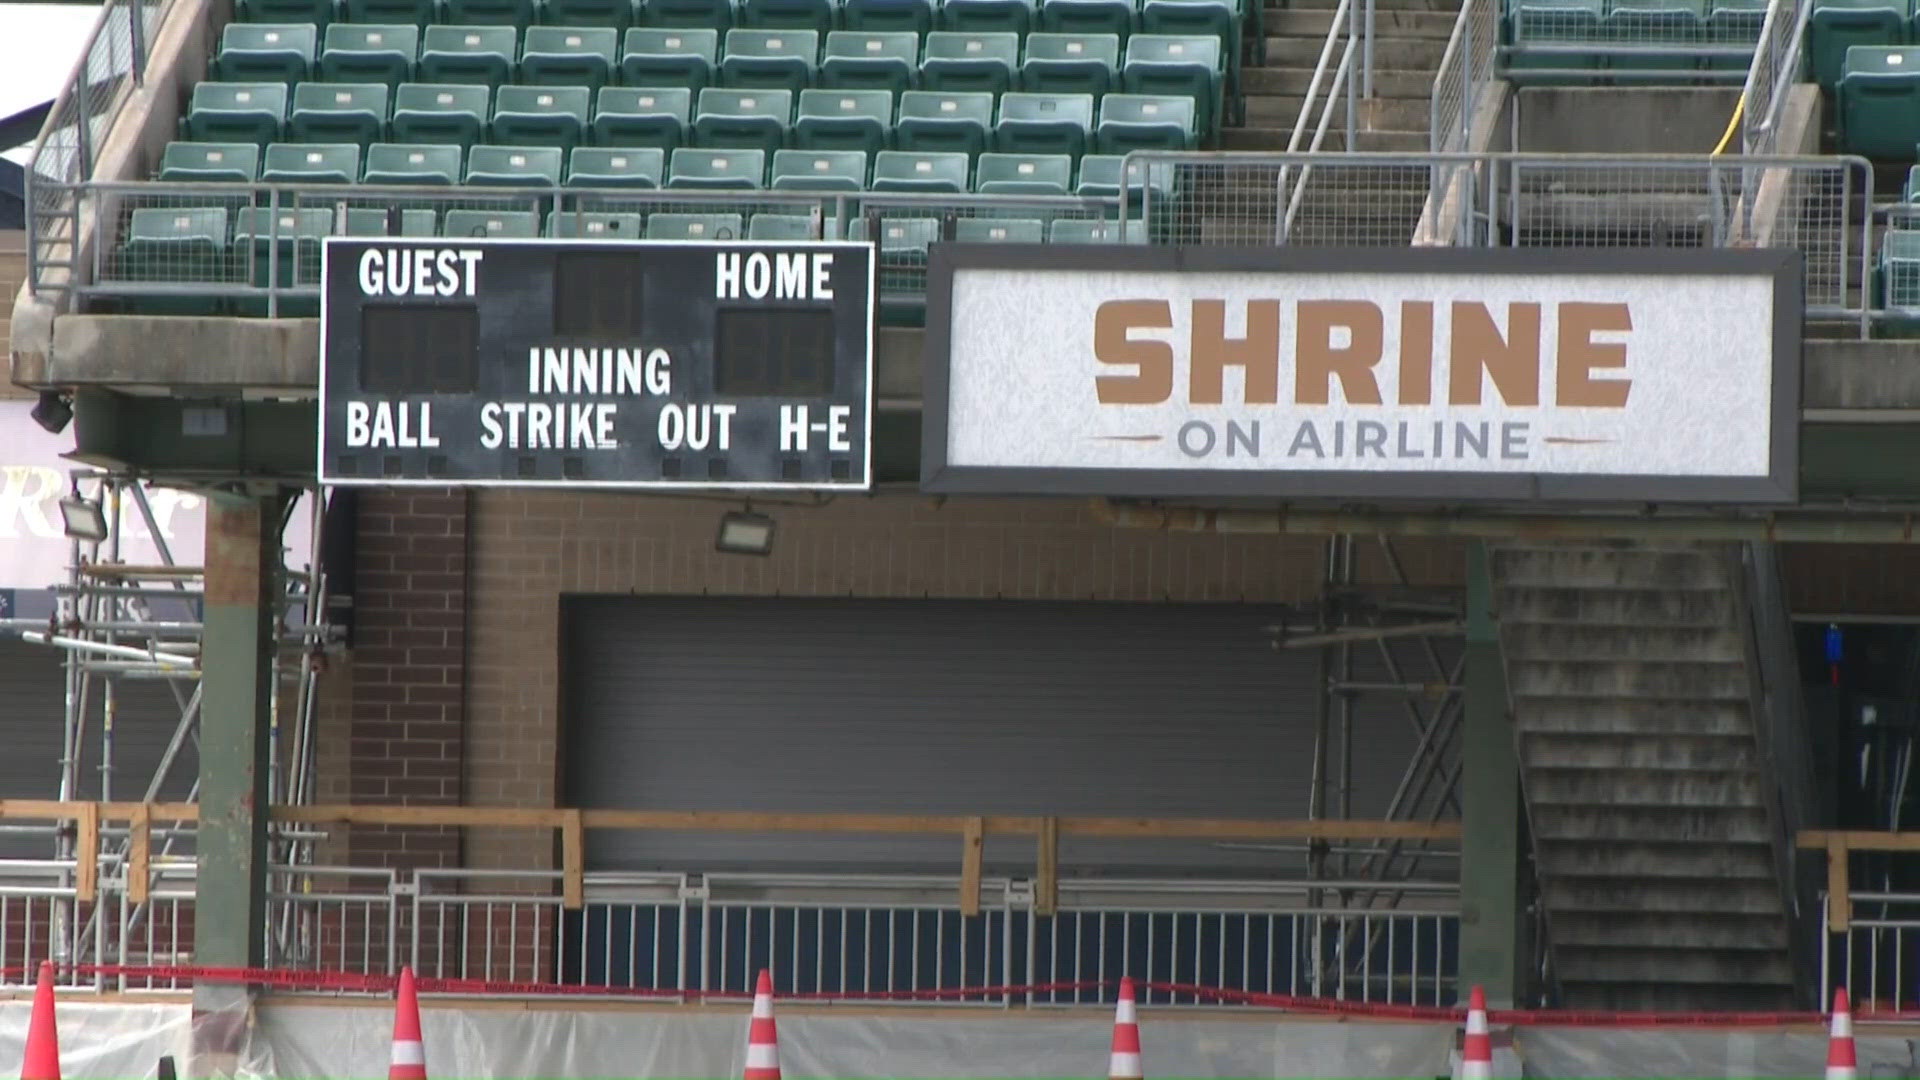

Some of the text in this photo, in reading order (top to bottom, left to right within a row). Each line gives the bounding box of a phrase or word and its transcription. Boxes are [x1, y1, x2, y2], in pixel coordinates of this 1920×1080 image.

[360, 249, 482, 296] GUEST
[717, 253, 833, 299] HOME
[530, 348, 670, 395] INNING
[1095, 298, 1633, 407] SHRINE
[347, 401, 850, 451] BALL STRIKE OUT H-E
[1178, 420, 1529, 459] ON AIRLINE
